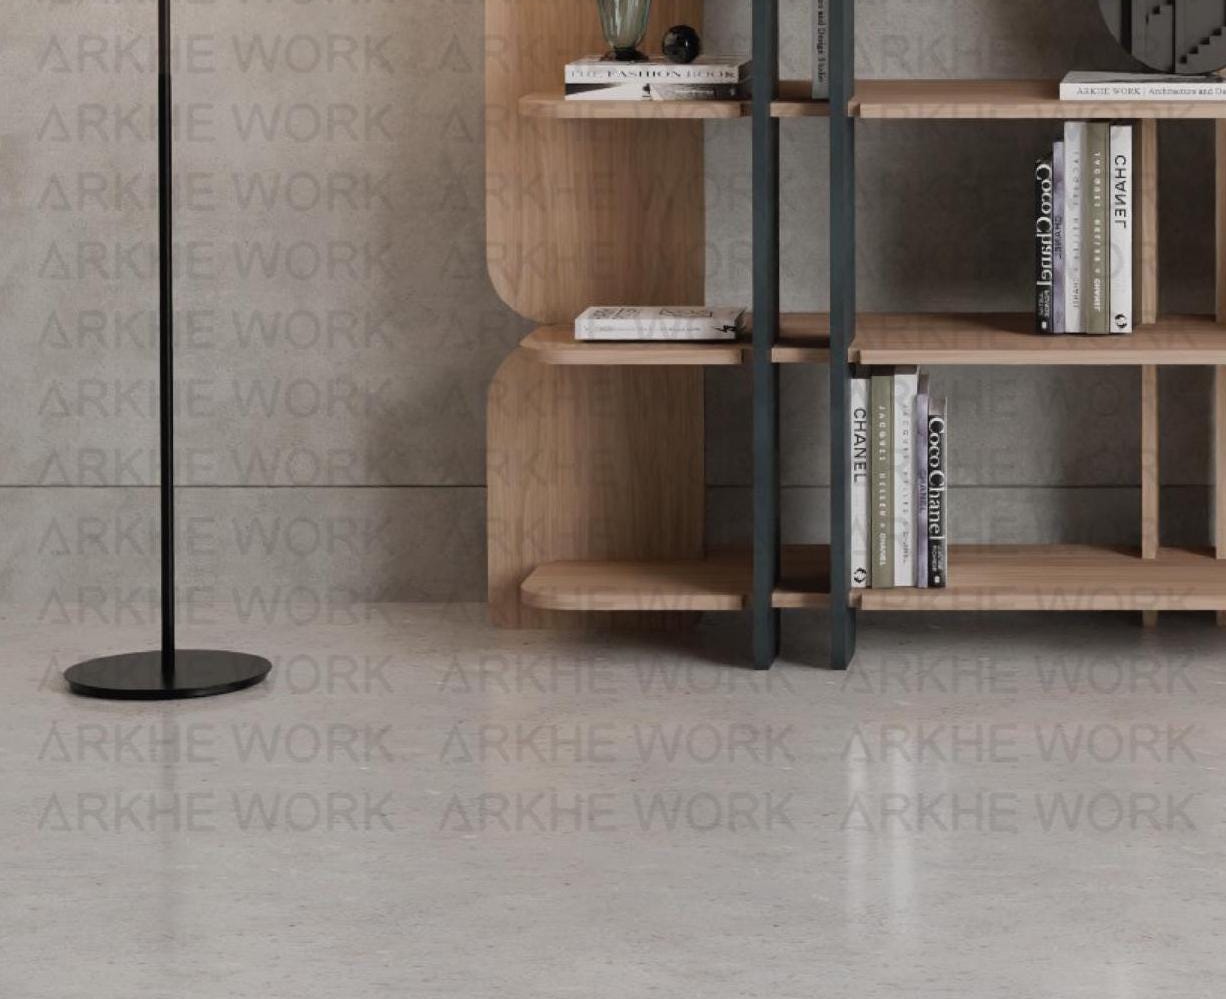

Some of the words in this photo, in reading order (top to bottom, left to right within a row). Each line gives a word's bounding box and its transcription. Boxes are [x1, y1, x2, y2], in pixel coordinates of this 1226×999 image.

[853, 407, 867, 483] CHANEL
[928, 416, 945, 467] Coco
[928, 470, 945, 540] Chanel
